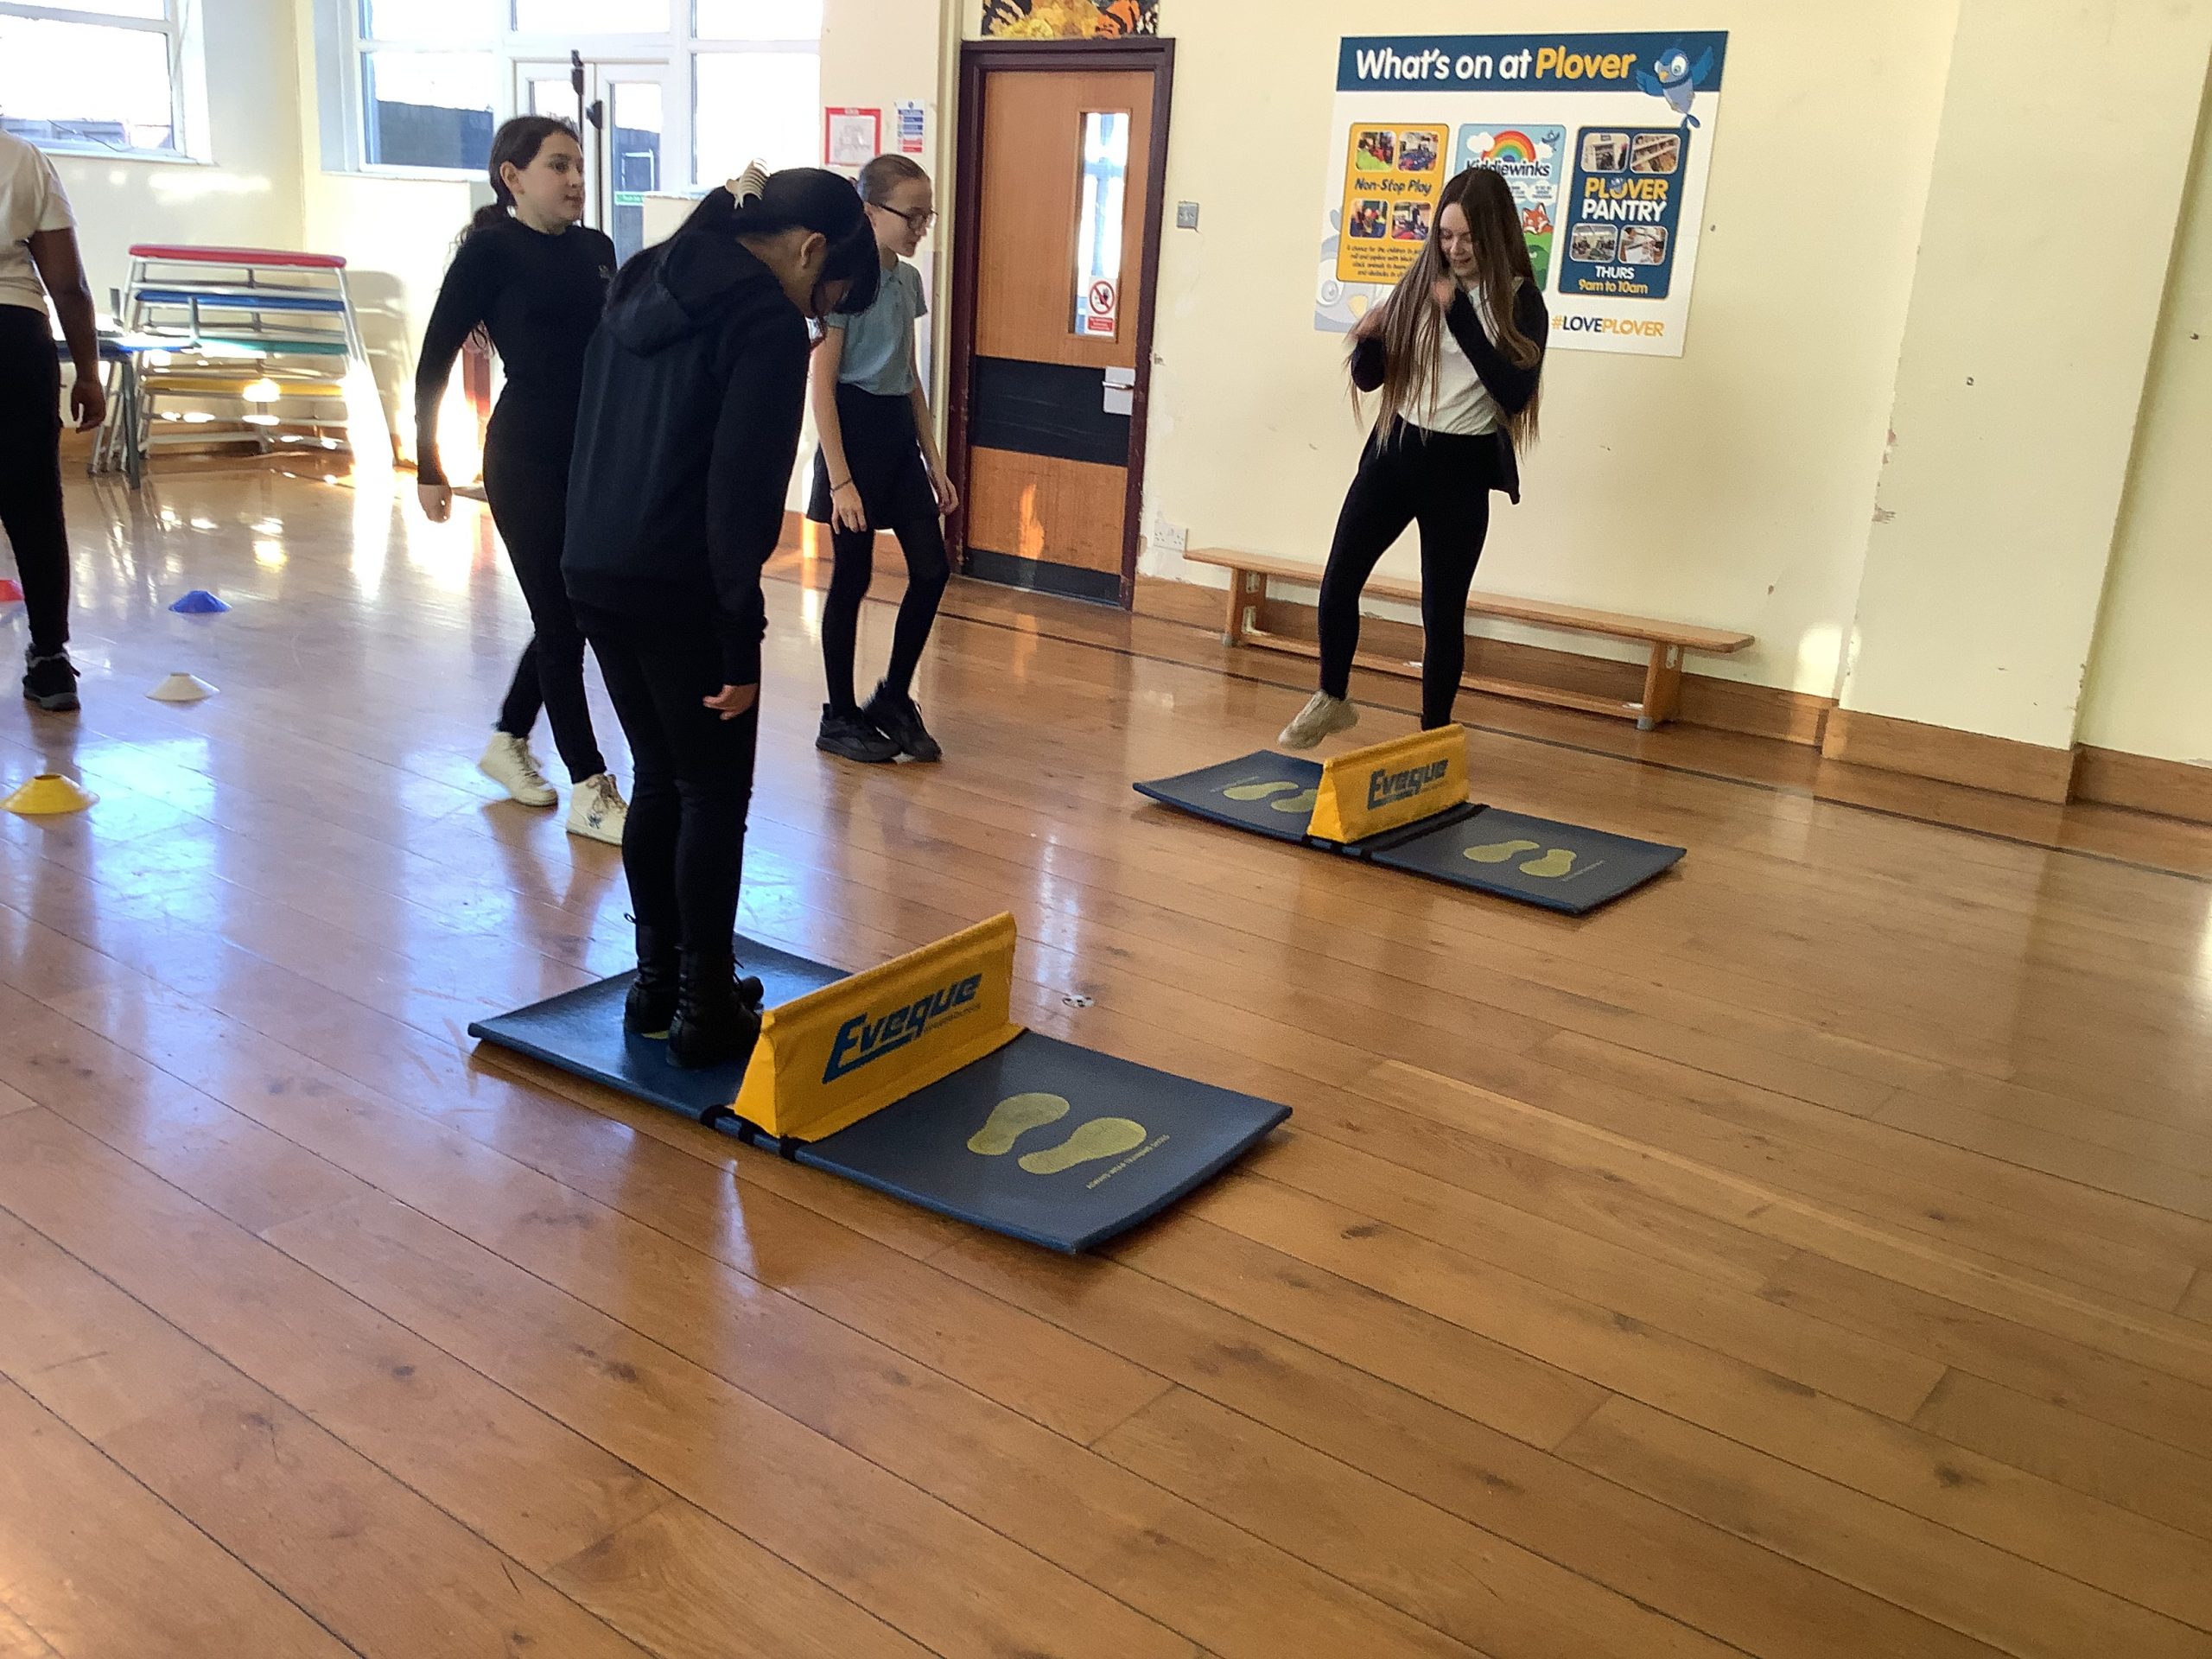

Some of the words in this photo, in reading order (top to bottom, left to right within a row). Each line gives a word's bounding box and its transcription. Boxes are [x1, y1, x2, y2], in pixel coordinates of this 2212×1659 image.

[1356, 47, 1451, 80] What's
[1455, 54, 1493, 79] on
[1499, 48, 1533, 79] at
[1535, 45, 1637, 79] Plover
[1355, 178, 1406, 195] Non-Stop
[1408, 178, 1432, 197] Play
[1584, 176, 1669, 200] PLOVER
[1581, 199, 1667, 222] PANTRY
[1595, 265, 1635, 280] THURS
[1578, 278, 1605, 291] 9am
[1605, 280, 1617, 292] to
[1618, 281, 1649, 295] 10am
[1551, 315, 1665, 337] #LOVEPLOVER
[822, 973, 982, 1084] Eveque
